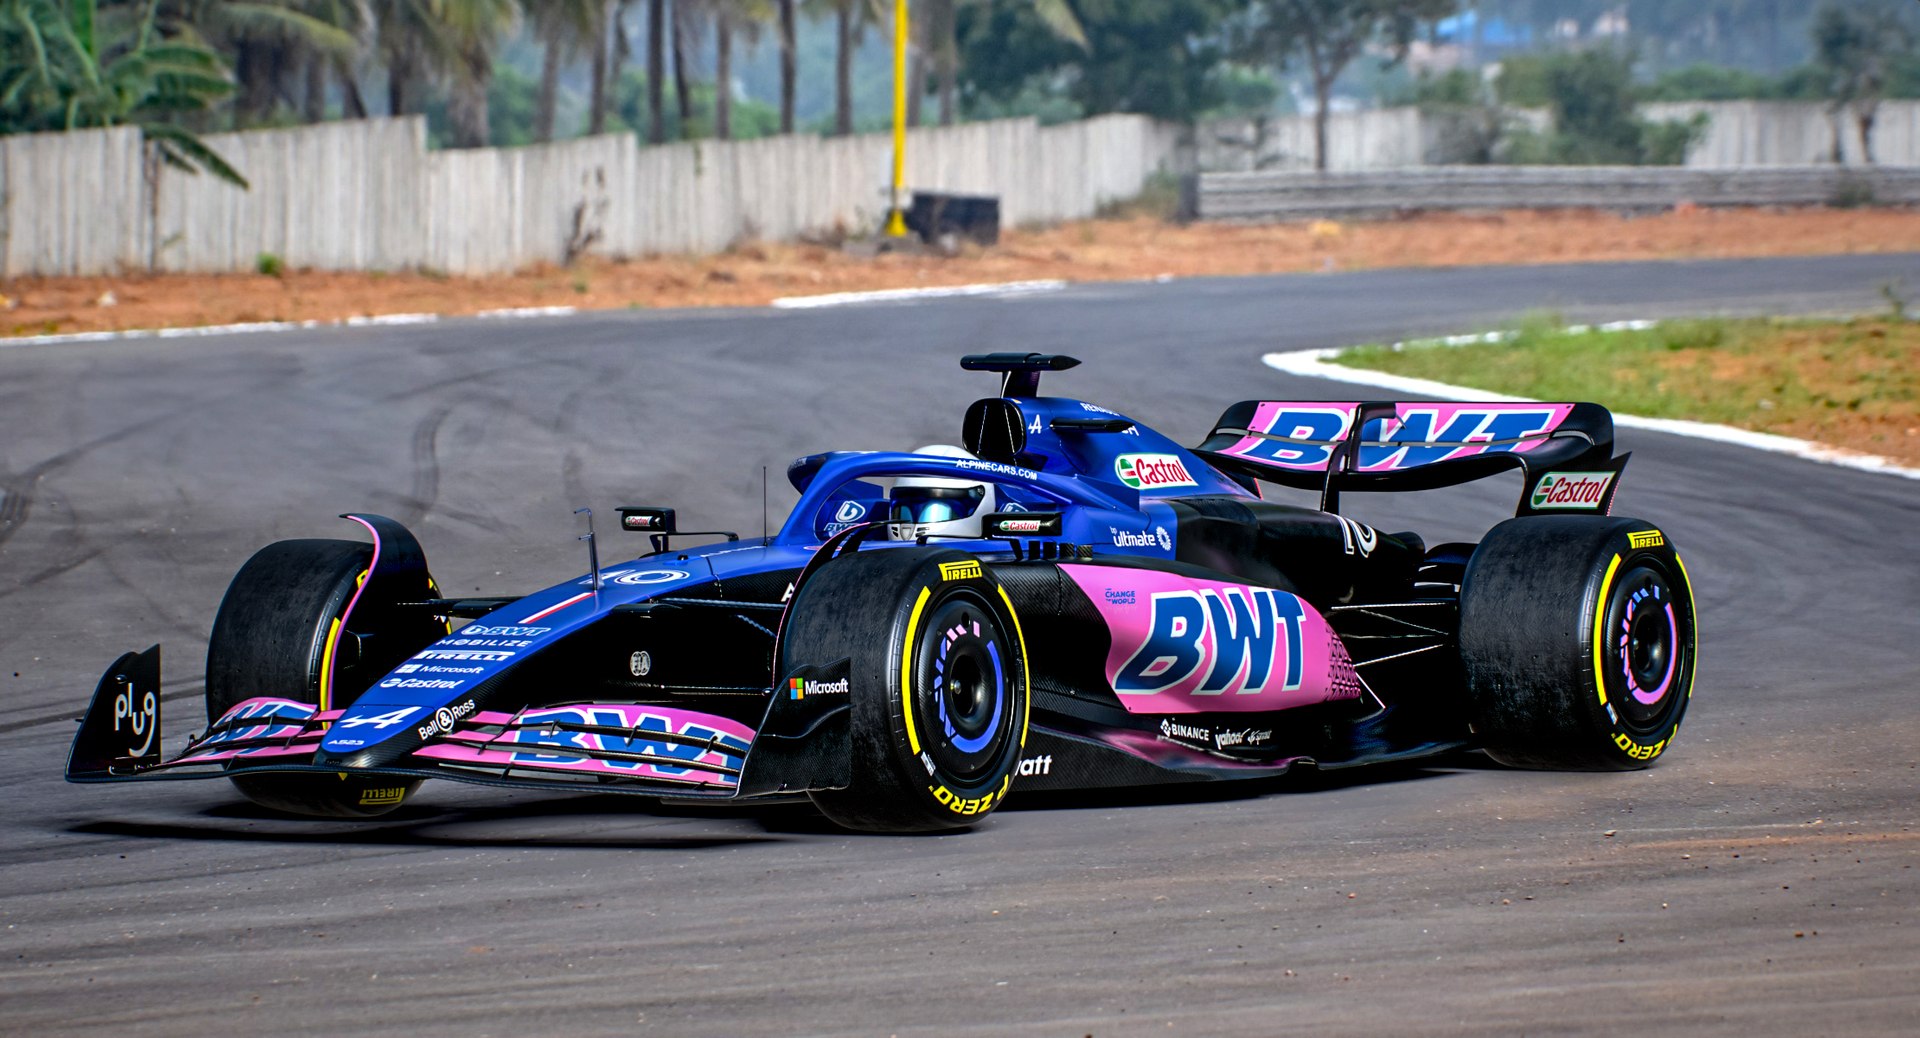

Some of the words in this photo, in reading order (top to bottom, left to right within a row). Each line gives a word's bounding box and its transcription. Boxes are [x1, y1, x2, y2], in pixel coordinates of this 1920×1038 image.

[1237, 407, 1556, 471] BWT
[956, 459, 1037, 480] ALPINECARS.COM
[1135, 458, 1192, 485] Castrol
[1546, 476, 1609, 503] Castrol
[1009, 521, 1039, 530] Castrol
[1113, 530, 1156, 547] ultimate
[1627, 529, 1664, 550] PIRELLI
[938, 559, 982, 582] PIRELLI
[485, 626, 551, 636] BWT
[1113, 586, 1307, 695] BWT
[412, 650, 516, 661] PIRELLI
[419, 665, 485, 674] Microsoft
[397, 678, 465, 689] Castrol
[805, 678, 849, 695] Microsoft
[114, 682, 156, 758] plug
[418, 721, 439, 741] Bell
[451, 699, 475, 720] Ross
[1171, 723, 1210, 741] BINANCE
[1614, 733, 1665, 760] ZERO
[359, 787, 406, 805] PIRELLI
[933, 785, 994, 815] ZERO
